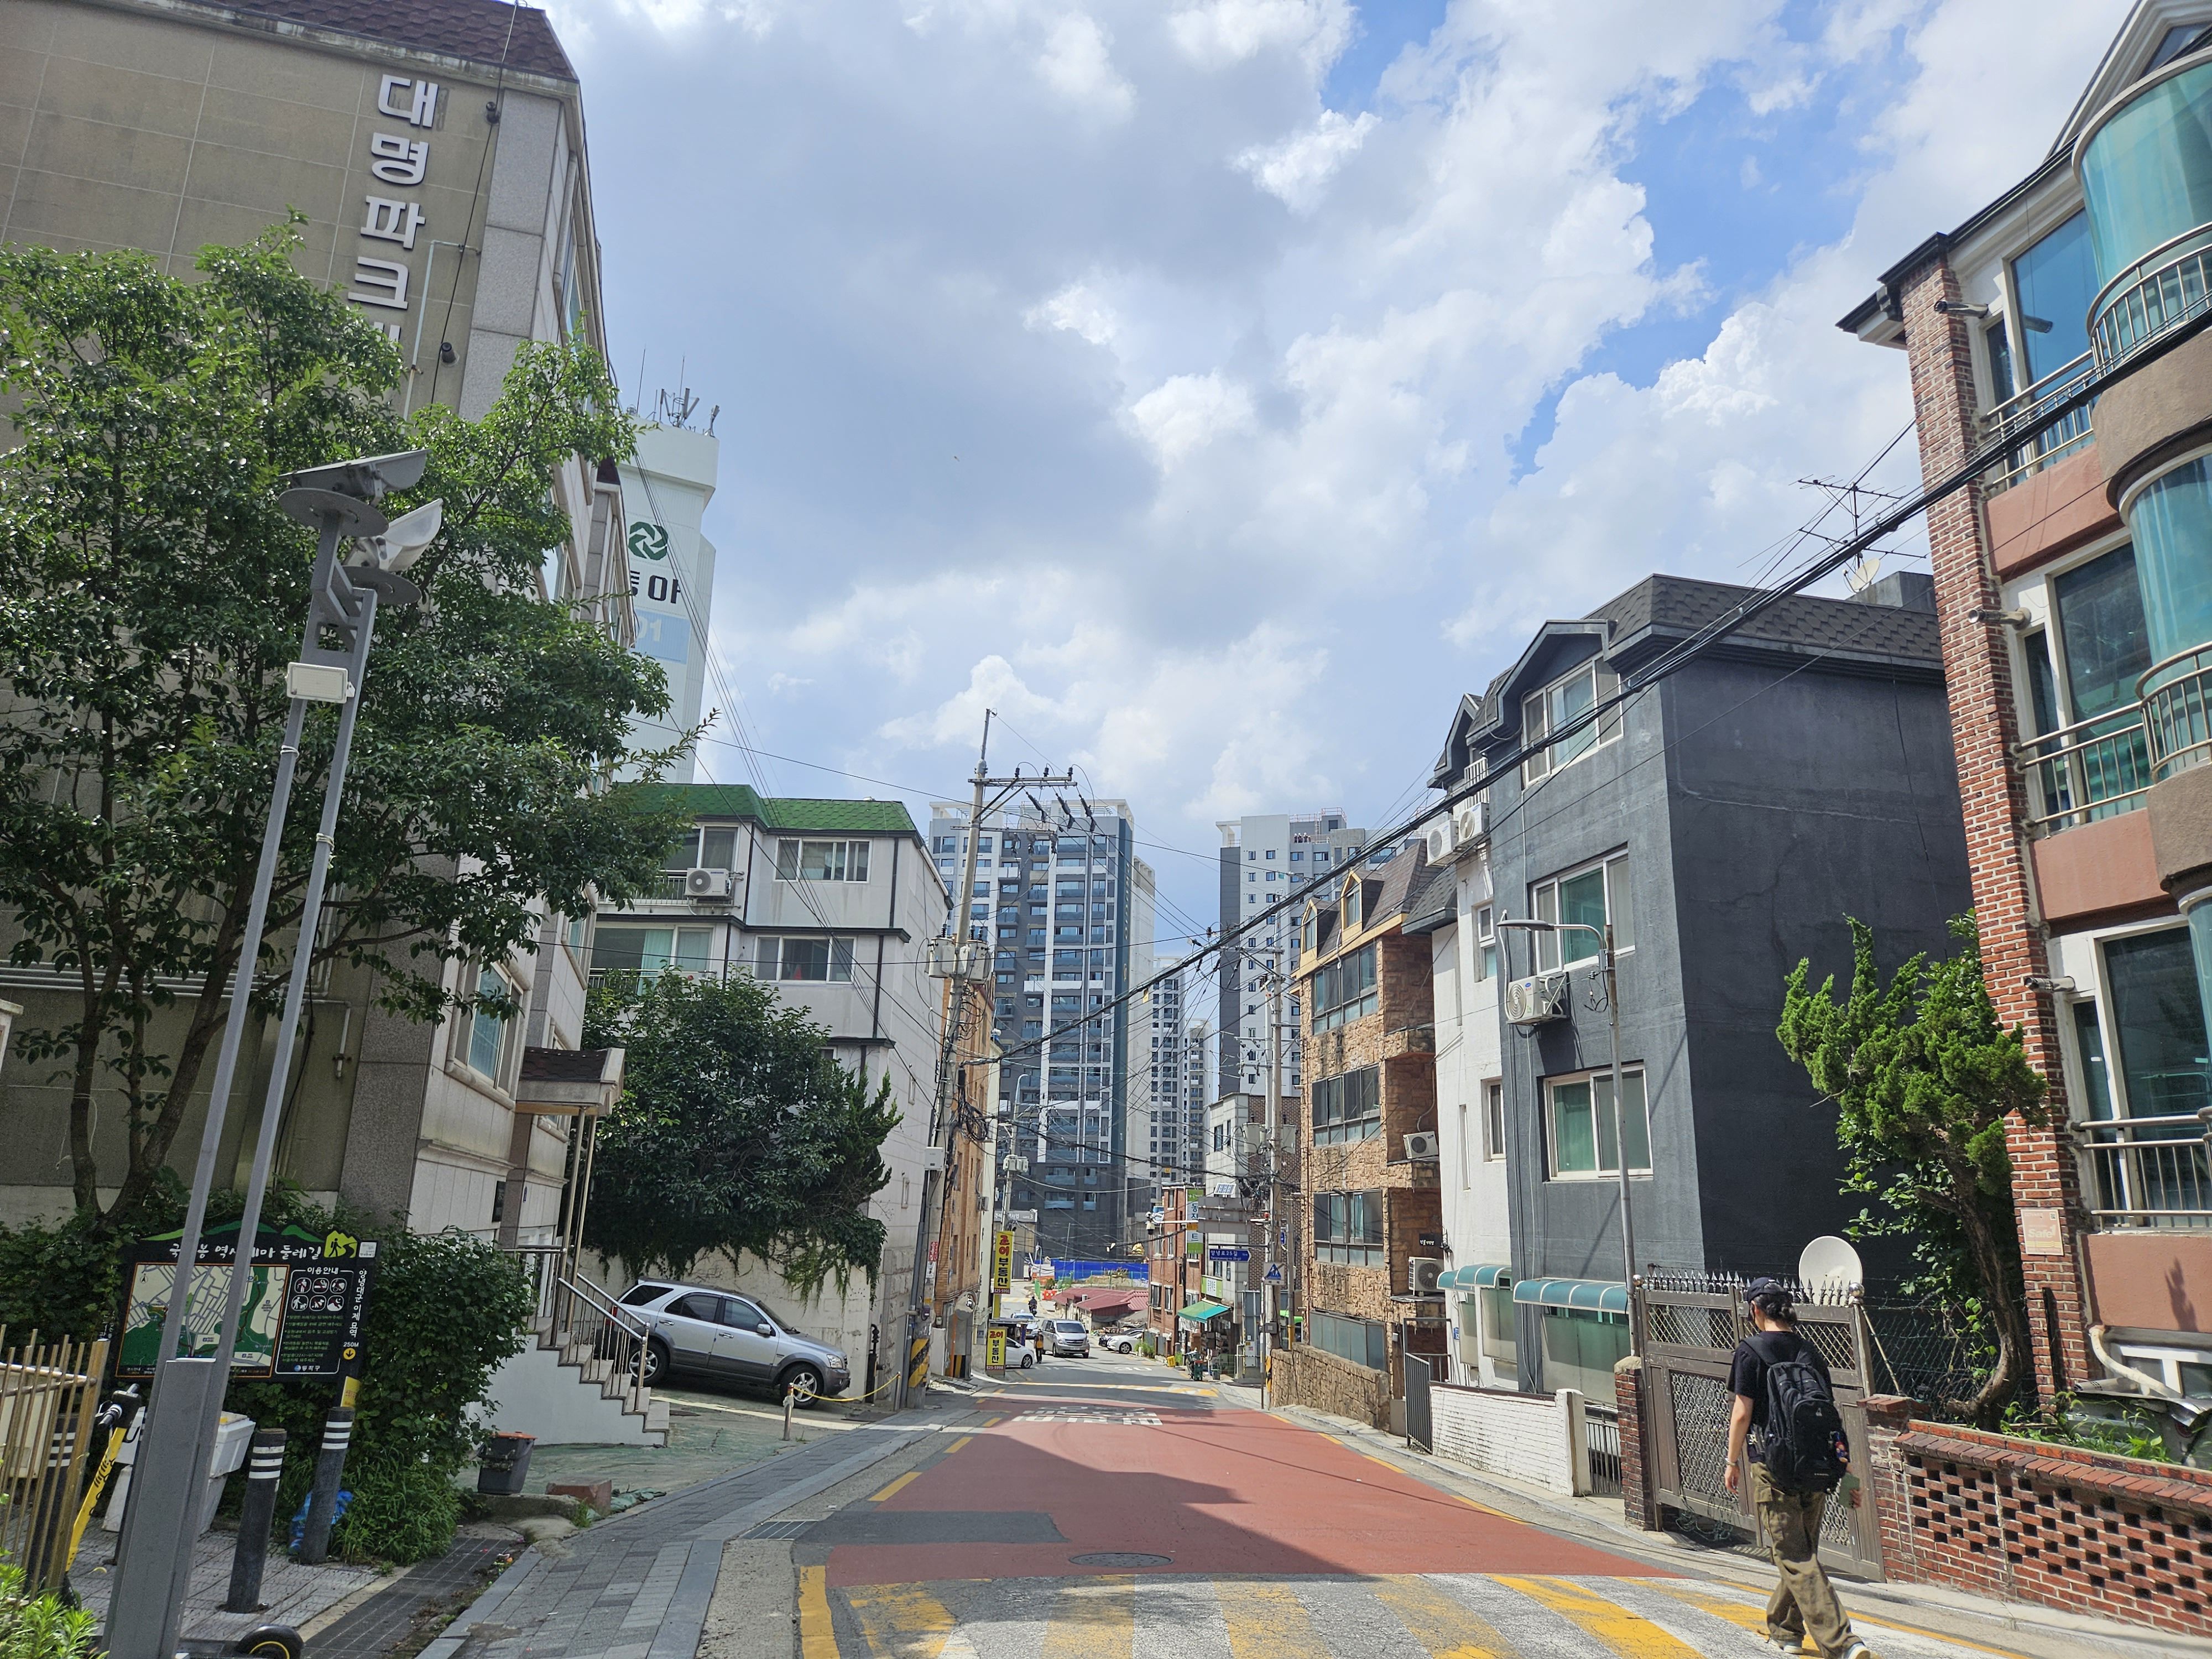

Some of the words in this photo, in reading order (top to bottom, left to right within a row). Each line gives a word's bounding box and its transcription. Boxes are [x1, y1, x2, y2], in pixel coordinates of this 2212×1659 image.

[169, 1244, 209, 1259] 국봉
[280, 1245, 322, 1260] 둘레길
[354, 1268, 368, 1303] 양녕대군
[998, 1257, 1009, 1287] 부동산
